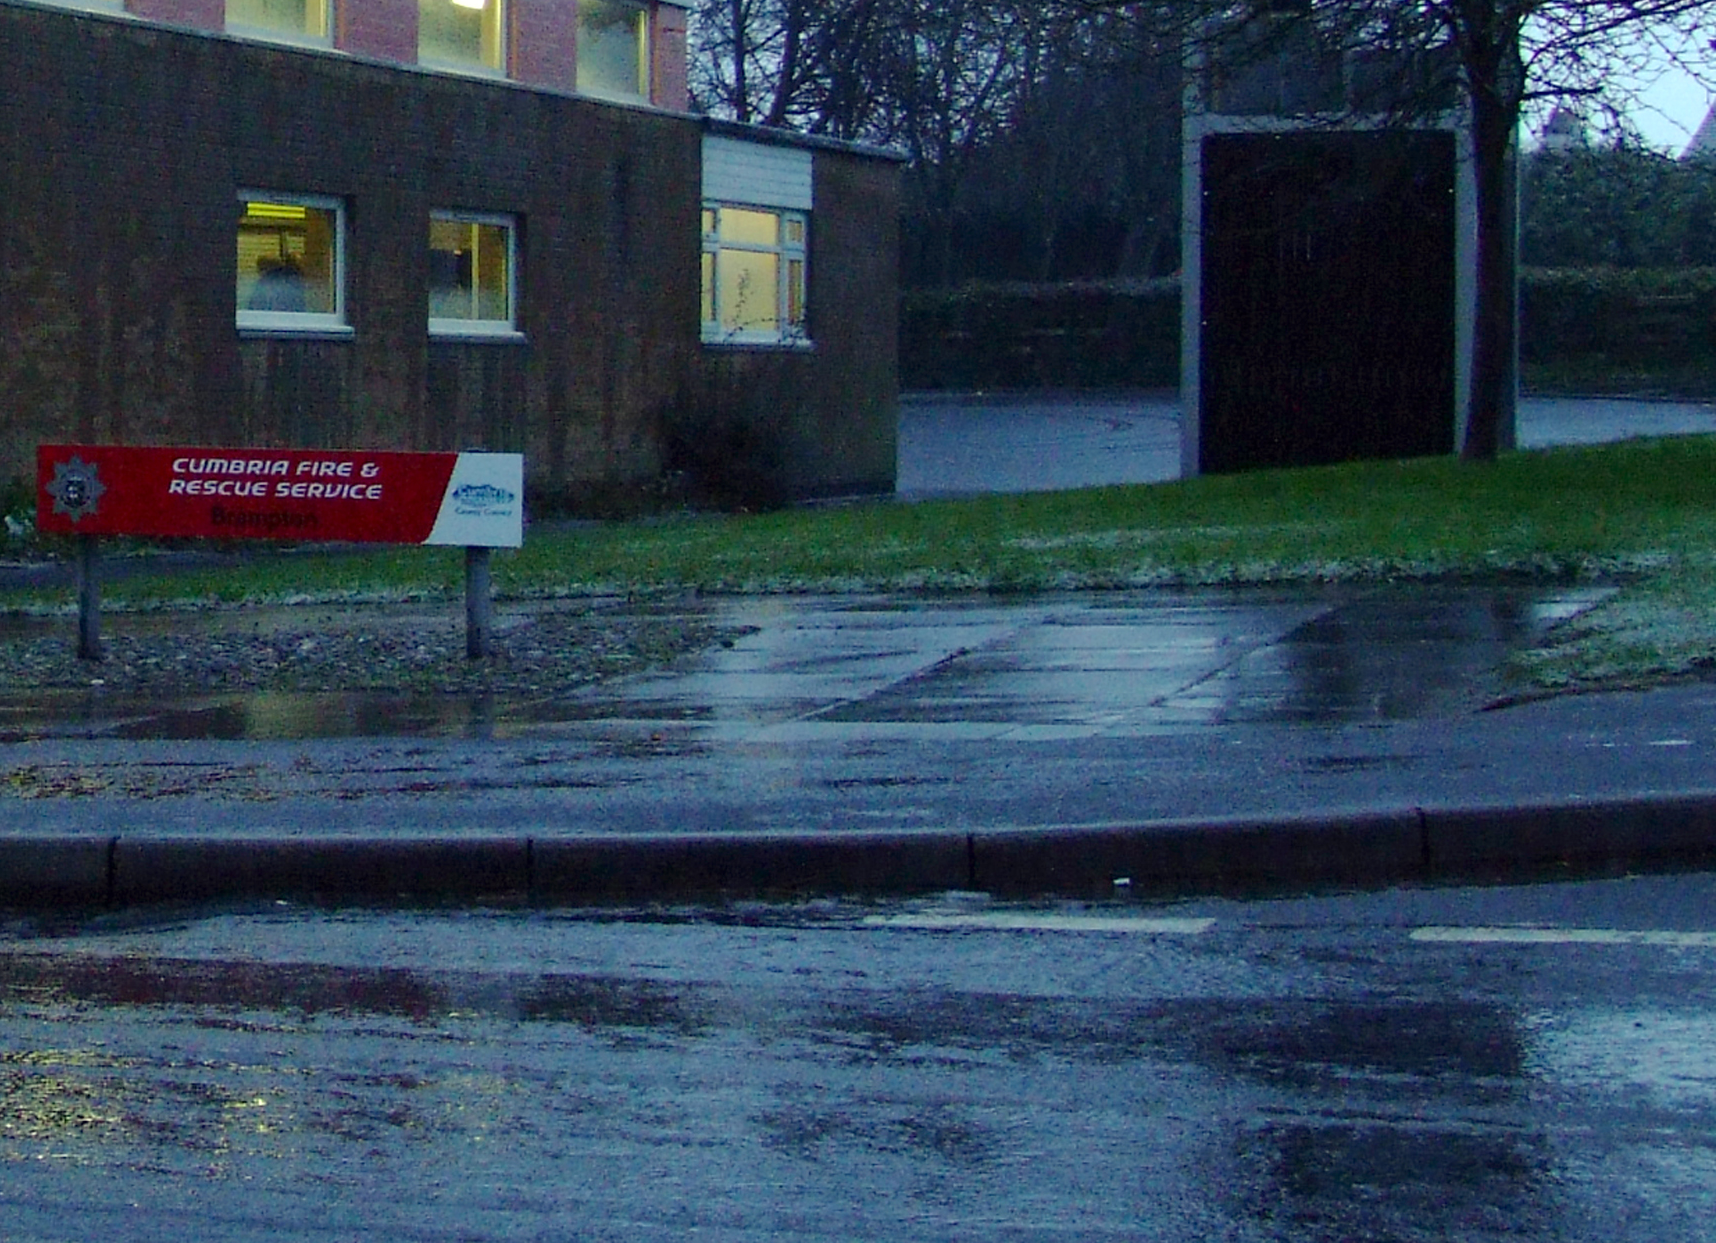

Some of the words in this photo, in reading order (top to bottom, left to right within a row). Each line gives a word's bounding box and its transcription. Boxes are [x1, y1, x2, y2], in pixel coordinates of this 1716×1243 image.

[172, 458, 290, 475] CUMBRIA
[295, 461, 353, 477] FIRE
[360, 462, 380, 478] &
[168, 479, 269, 497] RESCUE
[274, 482, 383, 499] SERVICE
[211, 505, 319, 530] Brampton
